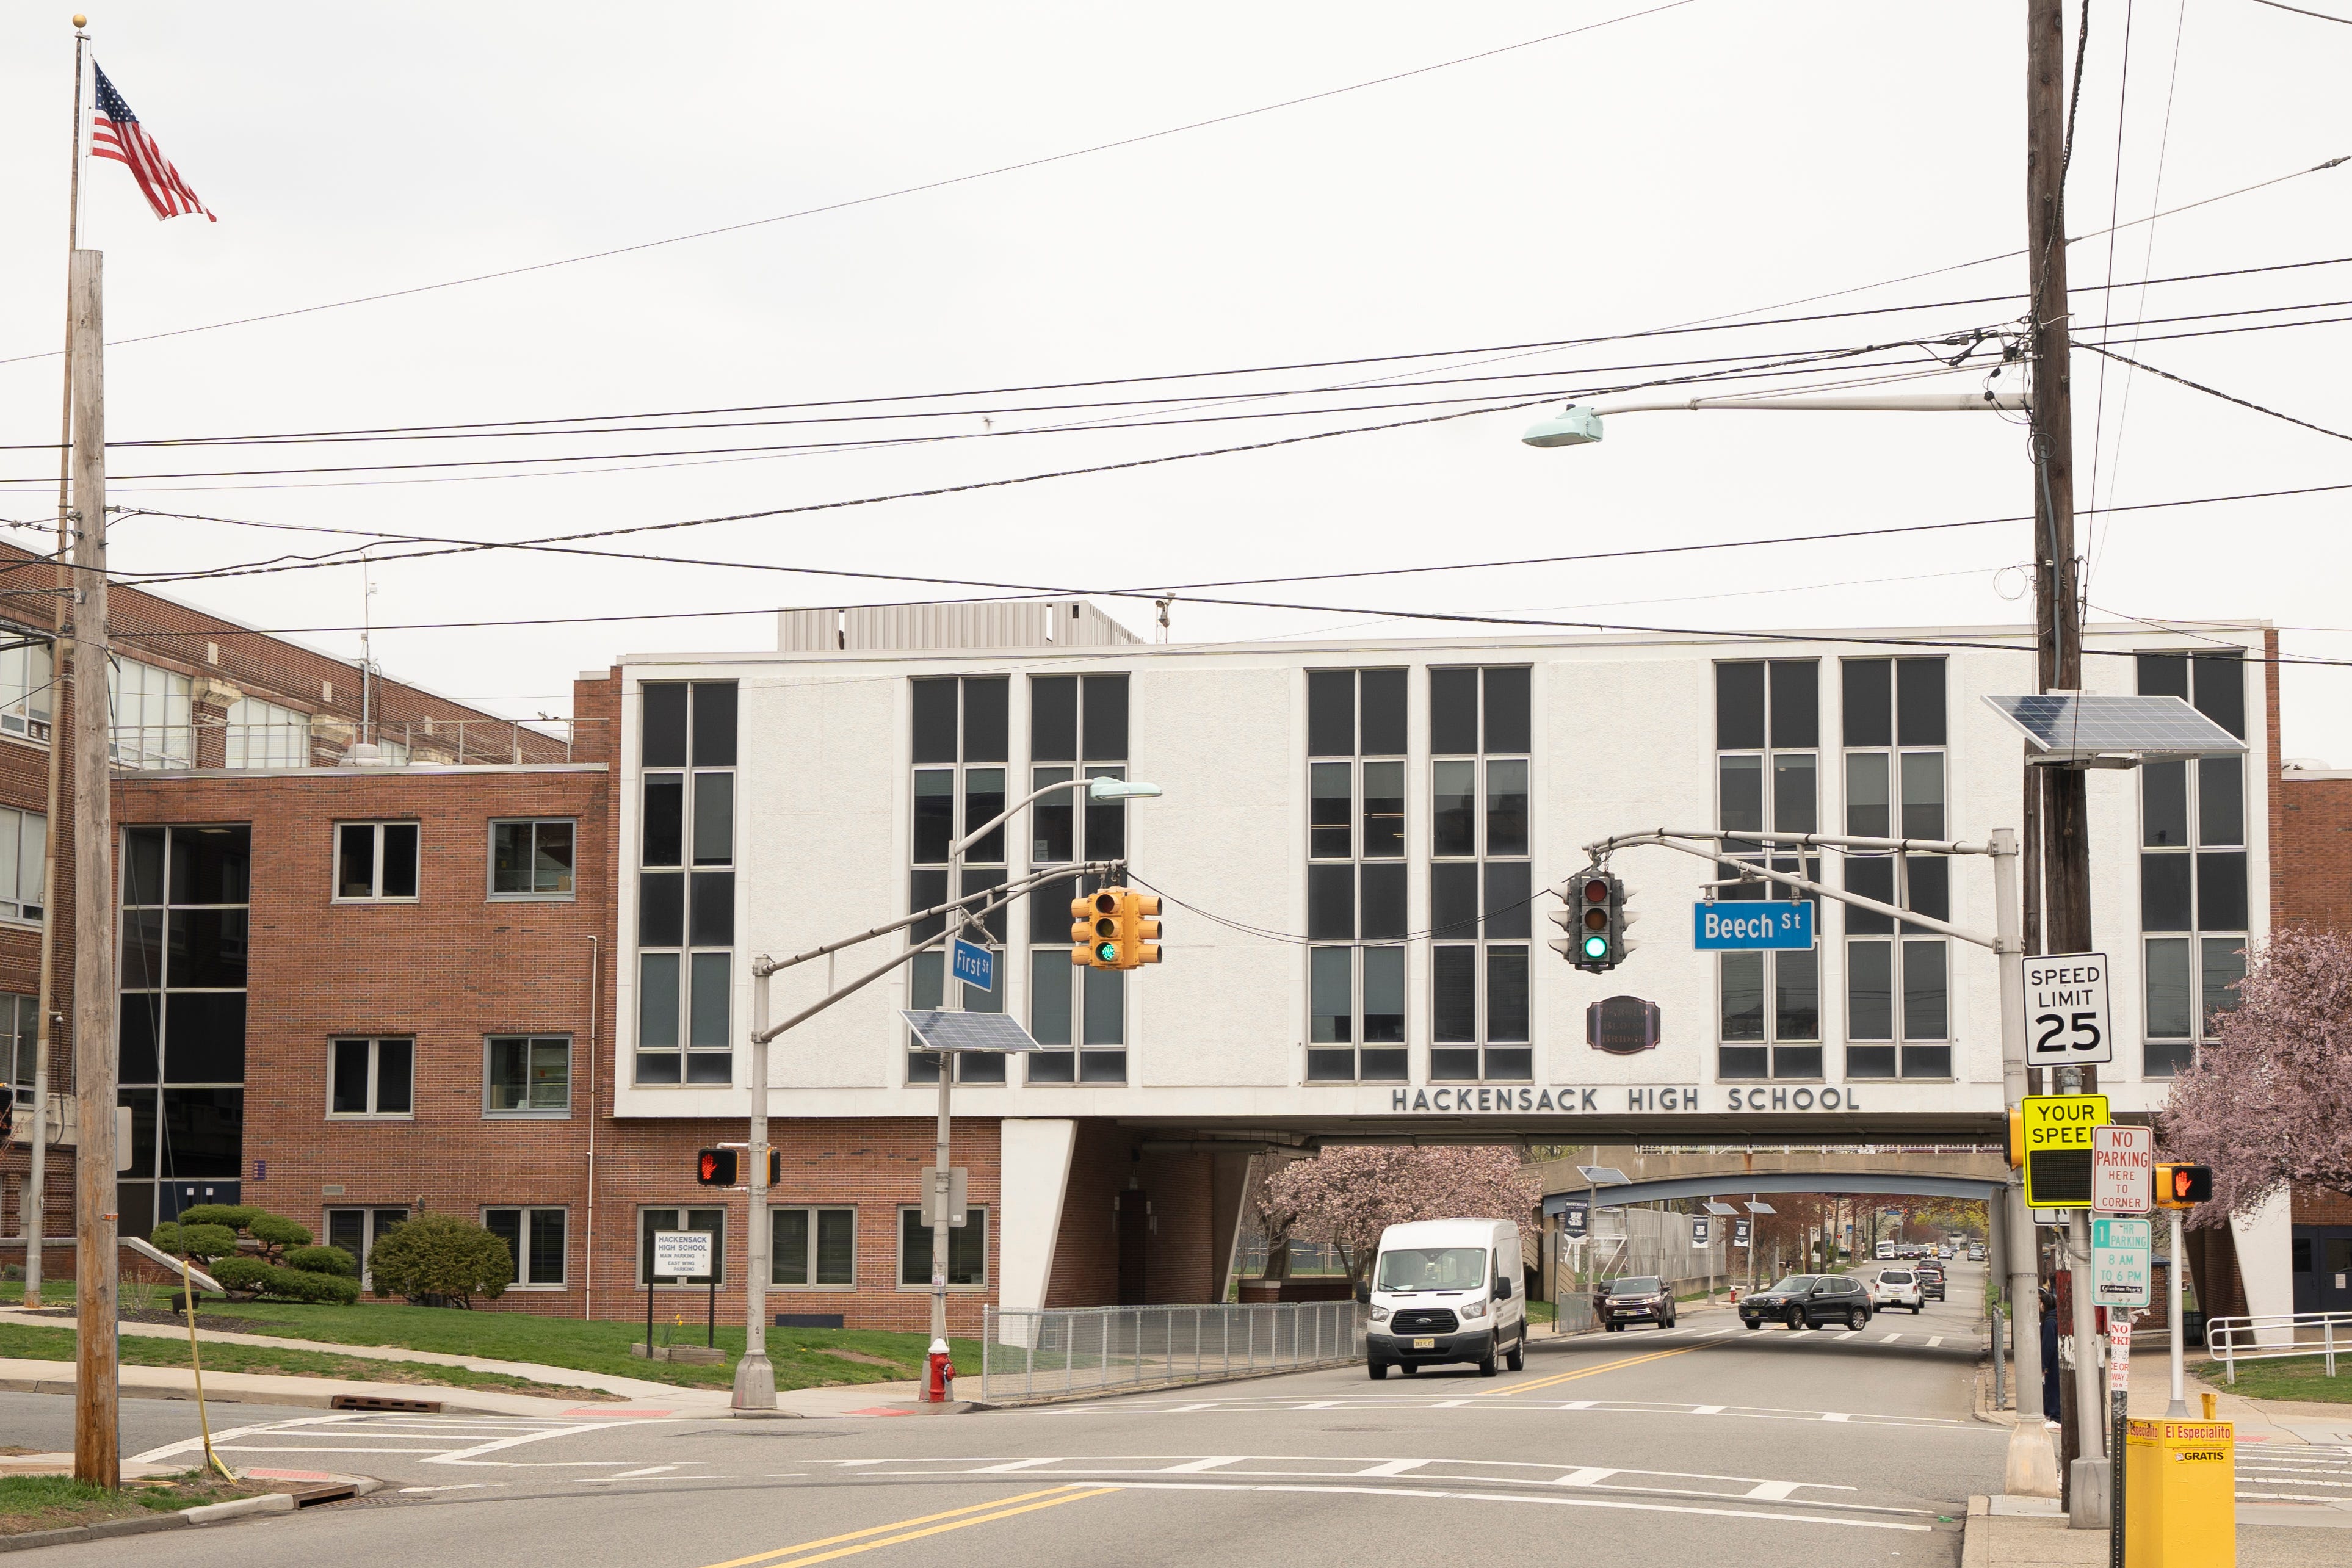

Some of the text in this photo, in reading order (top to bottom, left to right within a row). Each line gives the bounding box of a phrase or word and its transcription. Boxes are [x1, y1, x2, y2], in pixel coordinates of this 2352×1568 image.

[1705, 912, 1801, 939] Beech St
[957, 949, 990, 977] First St
[2031, 967, 2100, 986] SPEED
[2039, 989, 2093, 1008] LIMIT
[2035, 1011, 2101, 1053] 25
[1392, 1087, 1860, 1111] HACKENSACK HIGH SCHOOL
[2037, 1105, 2094, 1121] YOUR
[2032, 1127, 2094, 1143] SPEE
[2112, 1132, 2133, 1147] NO
[2097, 1151, 2148, 1168] PARKING
[2109, 1171, 2135, 1180] HERE
[2116, 1184, 2128, 1194] TO
[2102, 1197, 2141, 1207] CORNER
[2099, 1223, 2134, 1242] 1 HR
[2111, 1235, 2146, 1247] PARKING
[2108, 1254, 2133, 1265] 8 AM
[2101, 1270, 2141, 1281] TO 6 PM
[2111, 1324, 2128, 1334] NO
[2166, 1425, 2230, 1440] El Especialito
